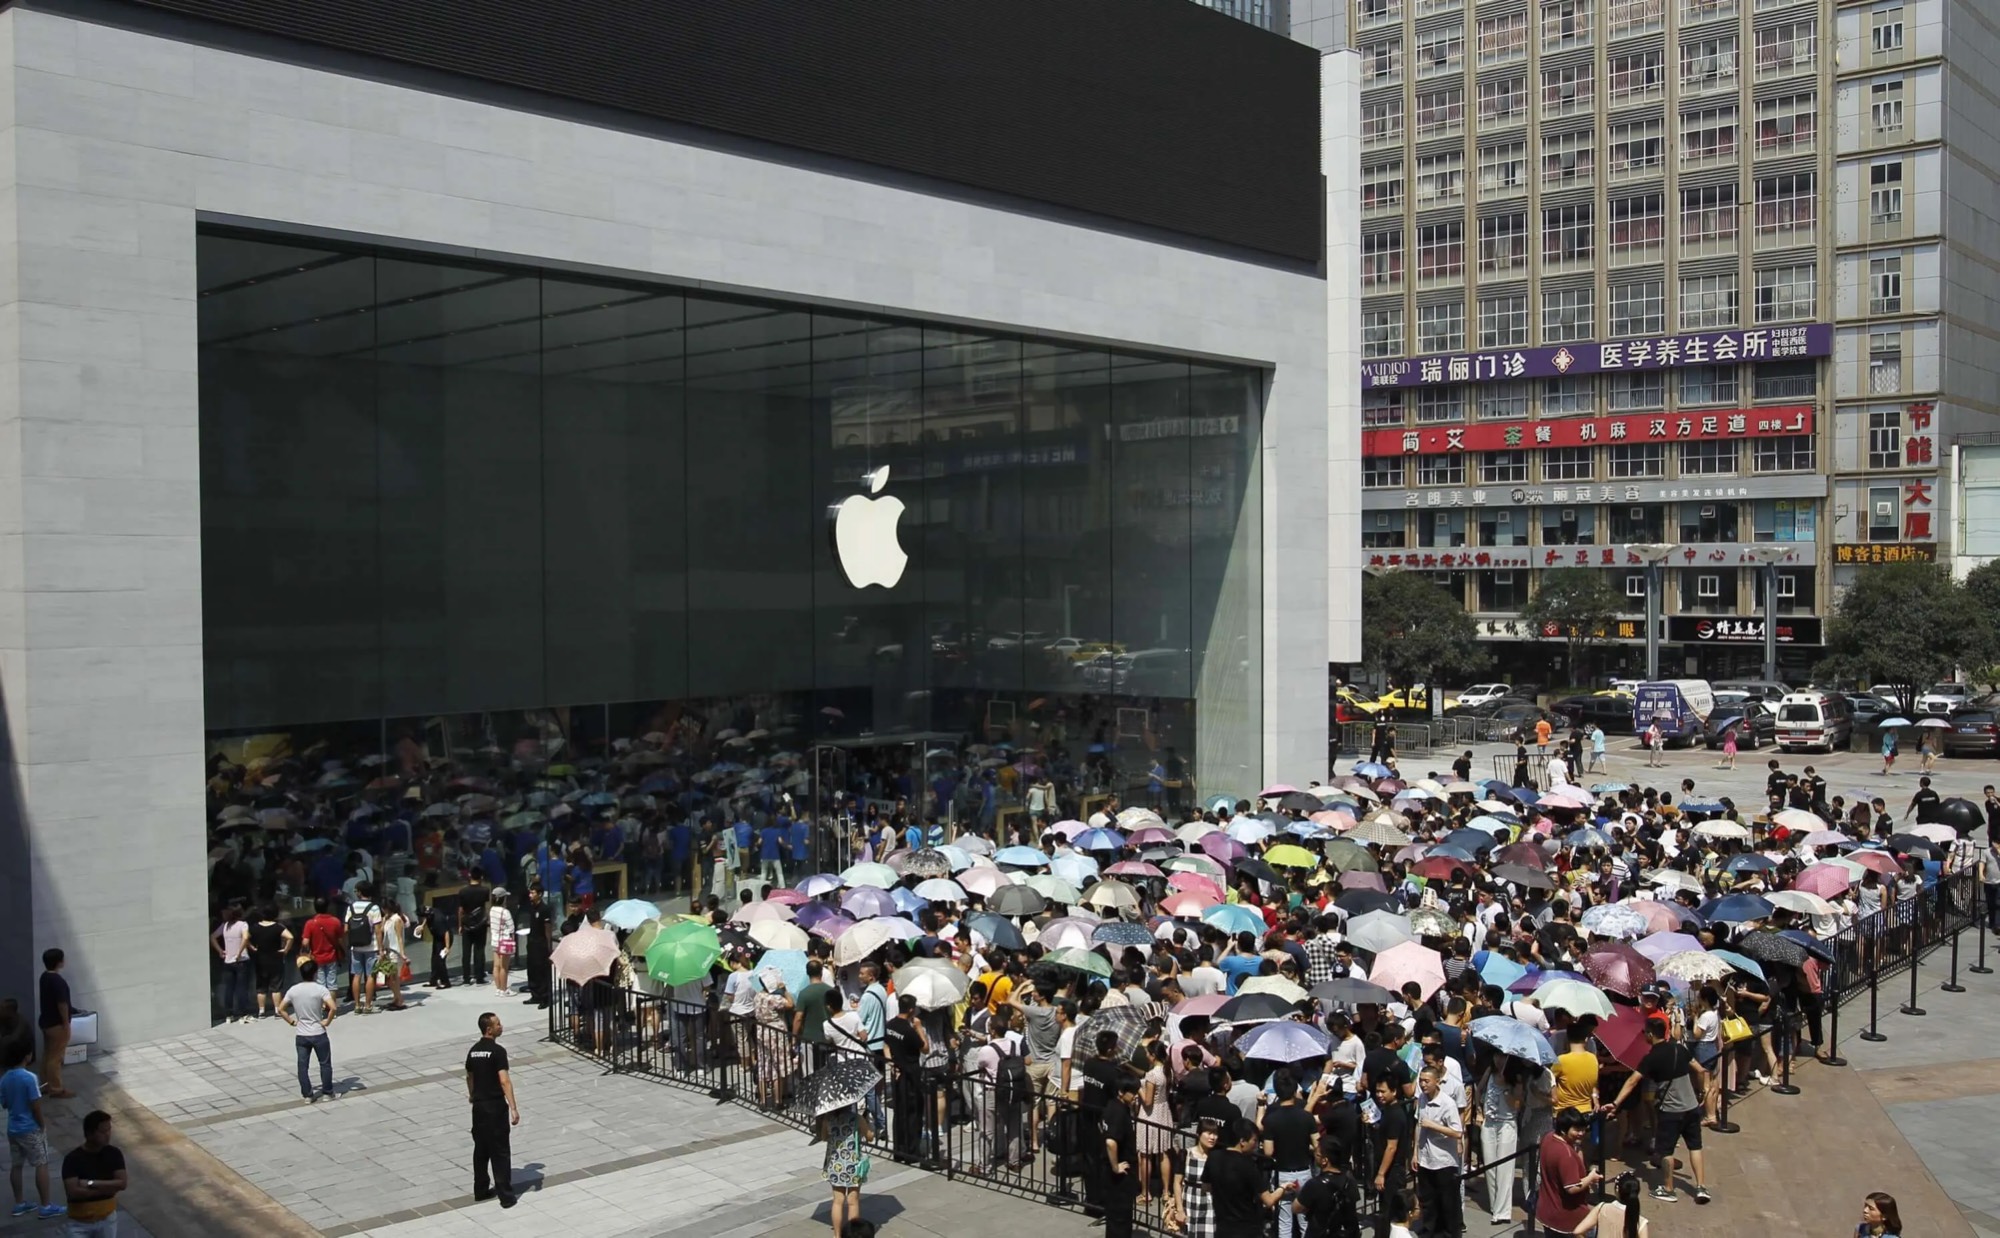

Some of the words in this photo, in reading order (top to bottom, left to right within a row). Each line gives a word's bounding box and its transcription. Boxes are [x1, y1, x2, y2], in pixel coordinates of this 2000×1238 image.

[1600, 330, 1768, 369] 医学养生会所
[1420, 352, 1526, 382] 瑞俪门诊
[1649, 415, 1747, 436] 汉方足道
[1759, 419, 1781, 431] 四楼
[1904, 403, 1934, 539] 节能大厦
[1553, 485, 1641, 502] 丽冠美容
